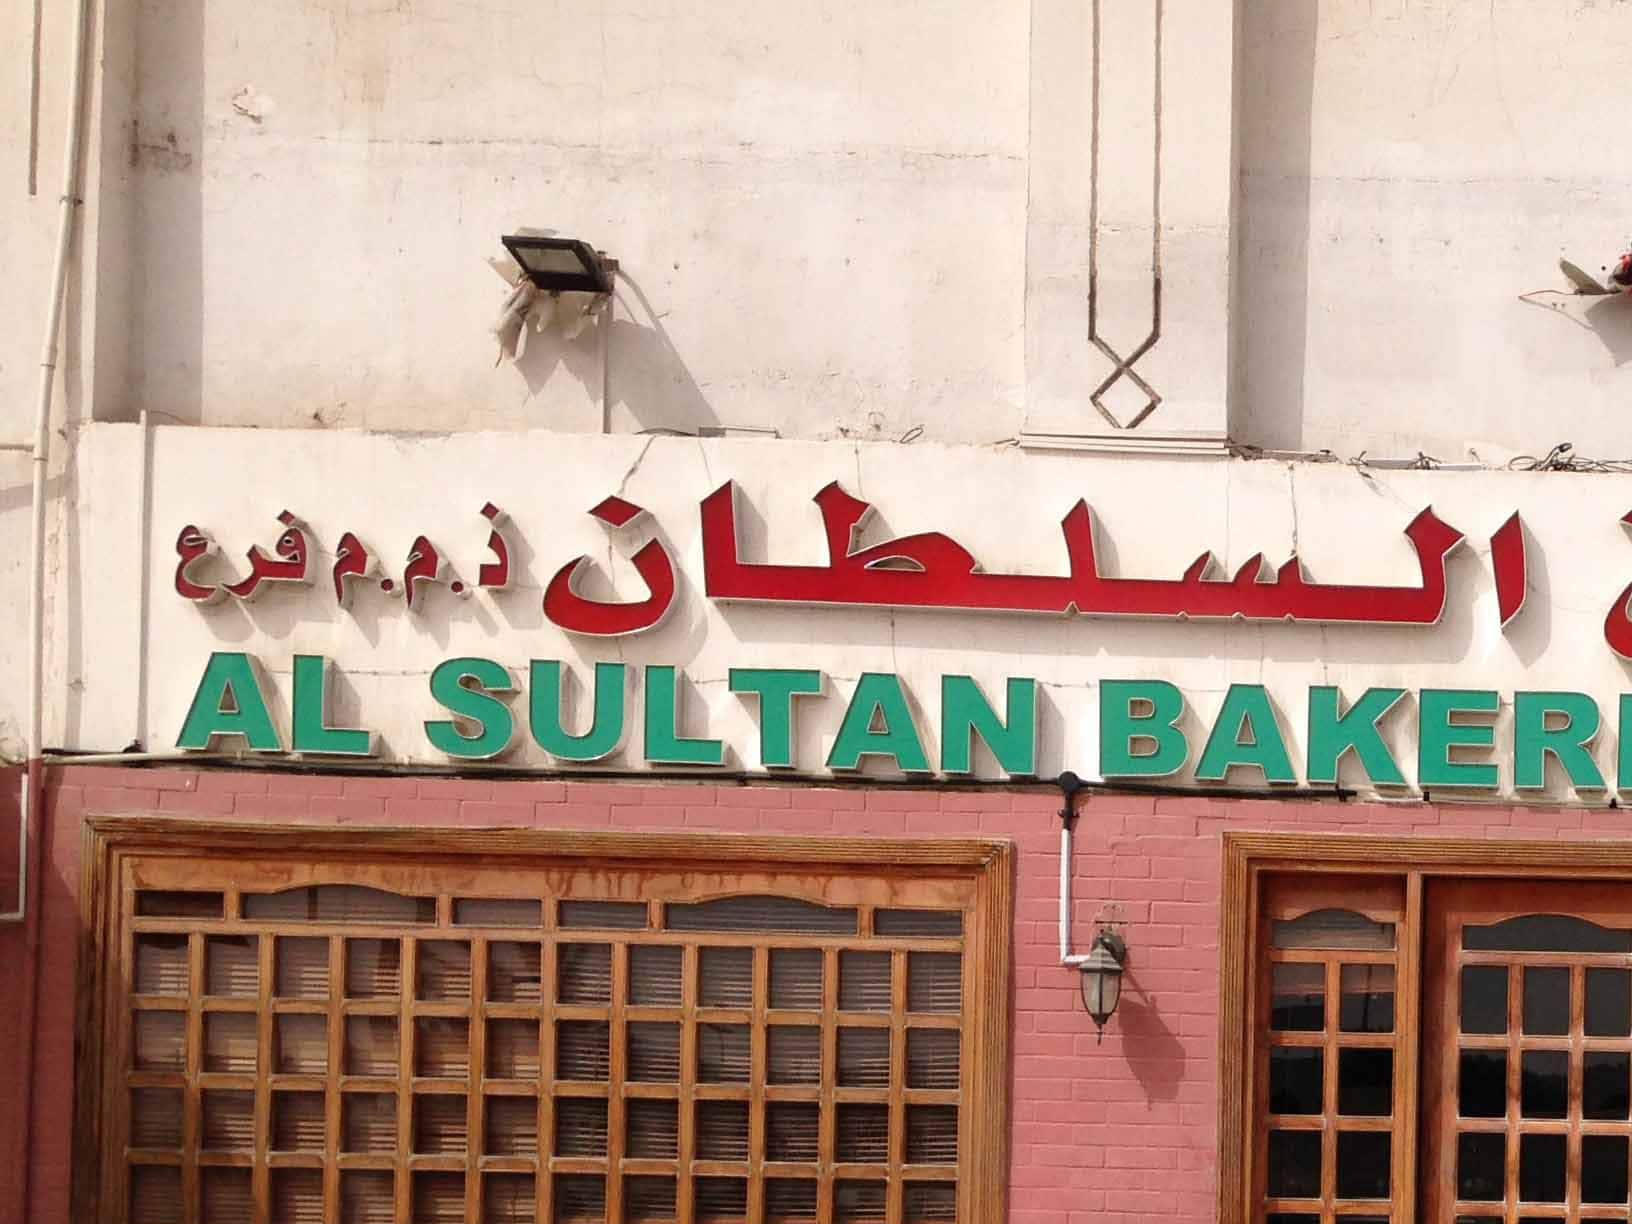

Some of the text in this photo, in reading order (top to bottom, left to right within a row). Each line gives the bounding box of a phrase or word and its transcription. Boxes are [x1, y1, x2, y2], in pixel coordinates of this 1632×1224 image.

[174, 508, 309, 600] فرع
[542, 479, 1527, 637] السلطان
[178, 651, 371, 754] AL
[424, 656, 1036, 775] SULTAN
